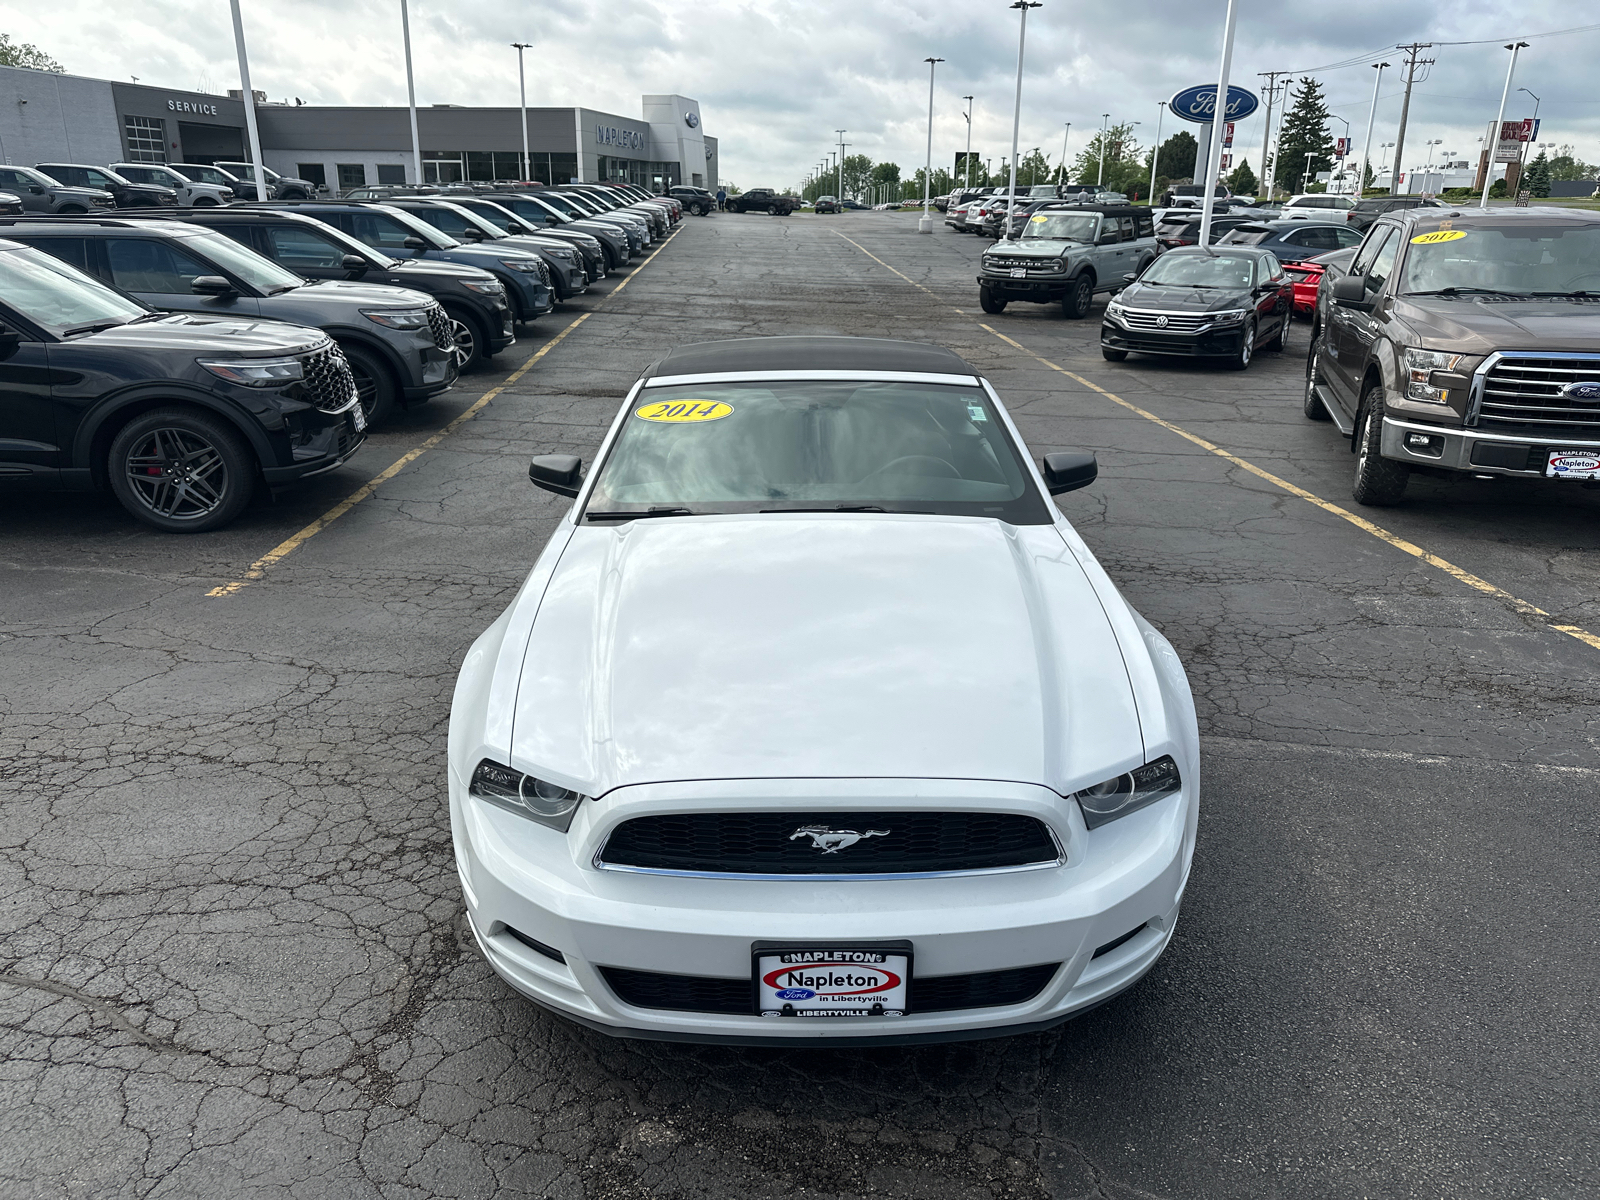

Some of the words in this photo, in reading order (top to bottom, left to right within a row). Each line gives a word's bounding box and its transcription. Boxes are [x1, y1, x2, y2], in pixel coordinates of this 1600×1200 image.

[168, 100, 217, 115] SERVICE
[1189, 91, 1242, 114] Fod
[596, 124, 645, 150] NAPLETON
[1419, 231, 1458, 243] 2017
[648, 403, 720, 418] 2014
[1558, 459, 1595, 468] Napleton
[790, 951, 877, 963] NAPLETON
[787, 972, 878, 990] Napleton
[783, 990, 809, 999] Ford
[831, 995, 889, 1003] Libertyville
